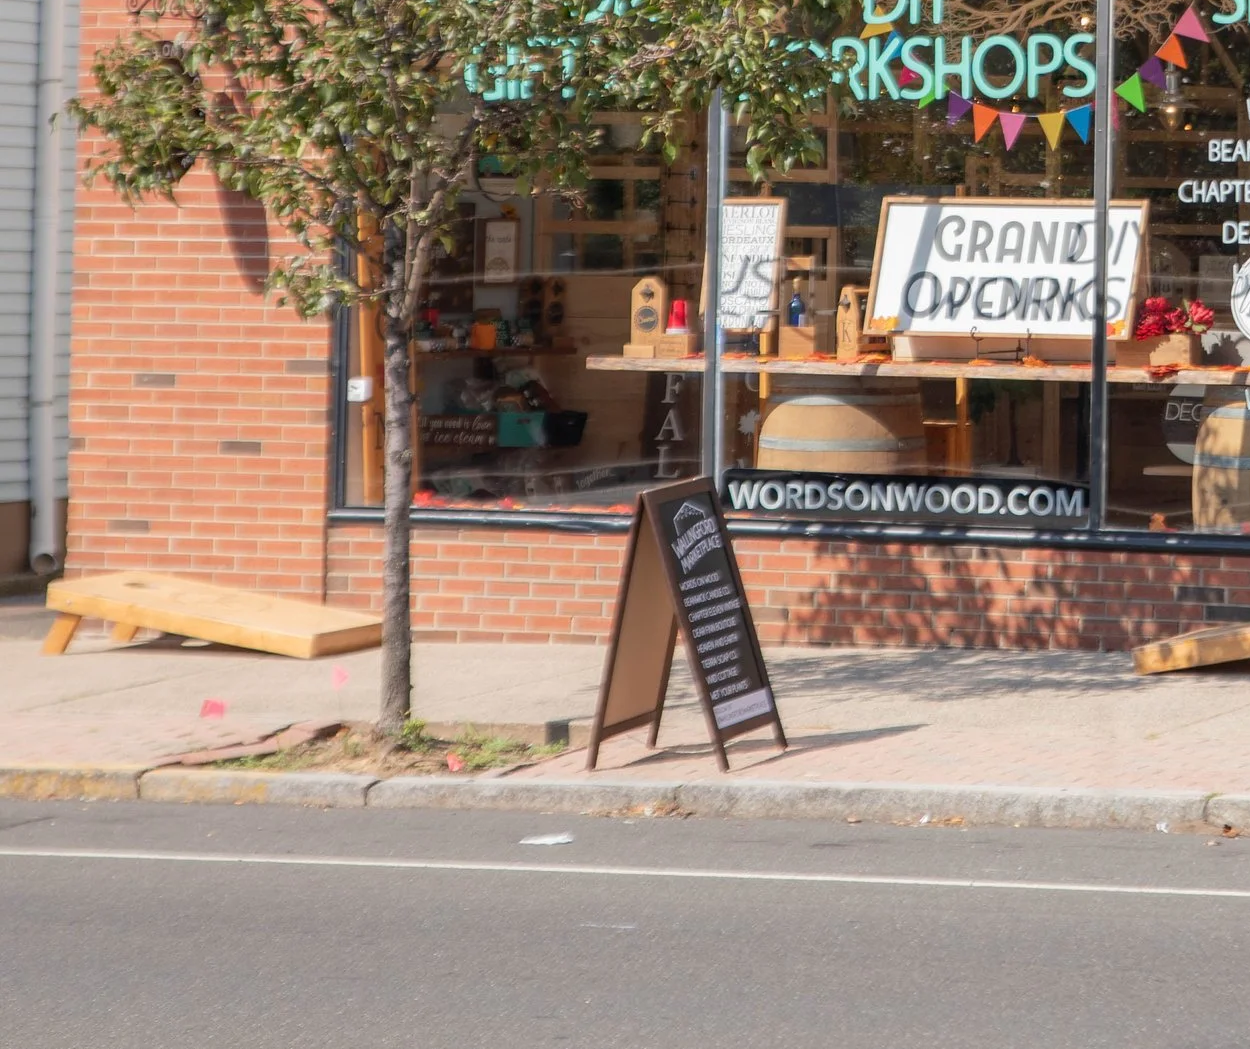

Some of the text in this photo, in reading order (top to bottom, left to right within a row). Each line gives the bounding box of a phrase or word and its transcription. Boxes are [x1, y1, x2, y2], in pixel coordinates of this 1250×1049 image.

[785, 33, 1097, 101] RKSHOPS
[721, 236, 775, 244] ORDEAUX
[933, 214, 1088, 264] GRAND
[728, 479, 1085, 517] WORDSONWOOD.COM
[671, 518, 716, 560] WALLINGFORD
[680, 535, 721, 575] MARKETPLACE
